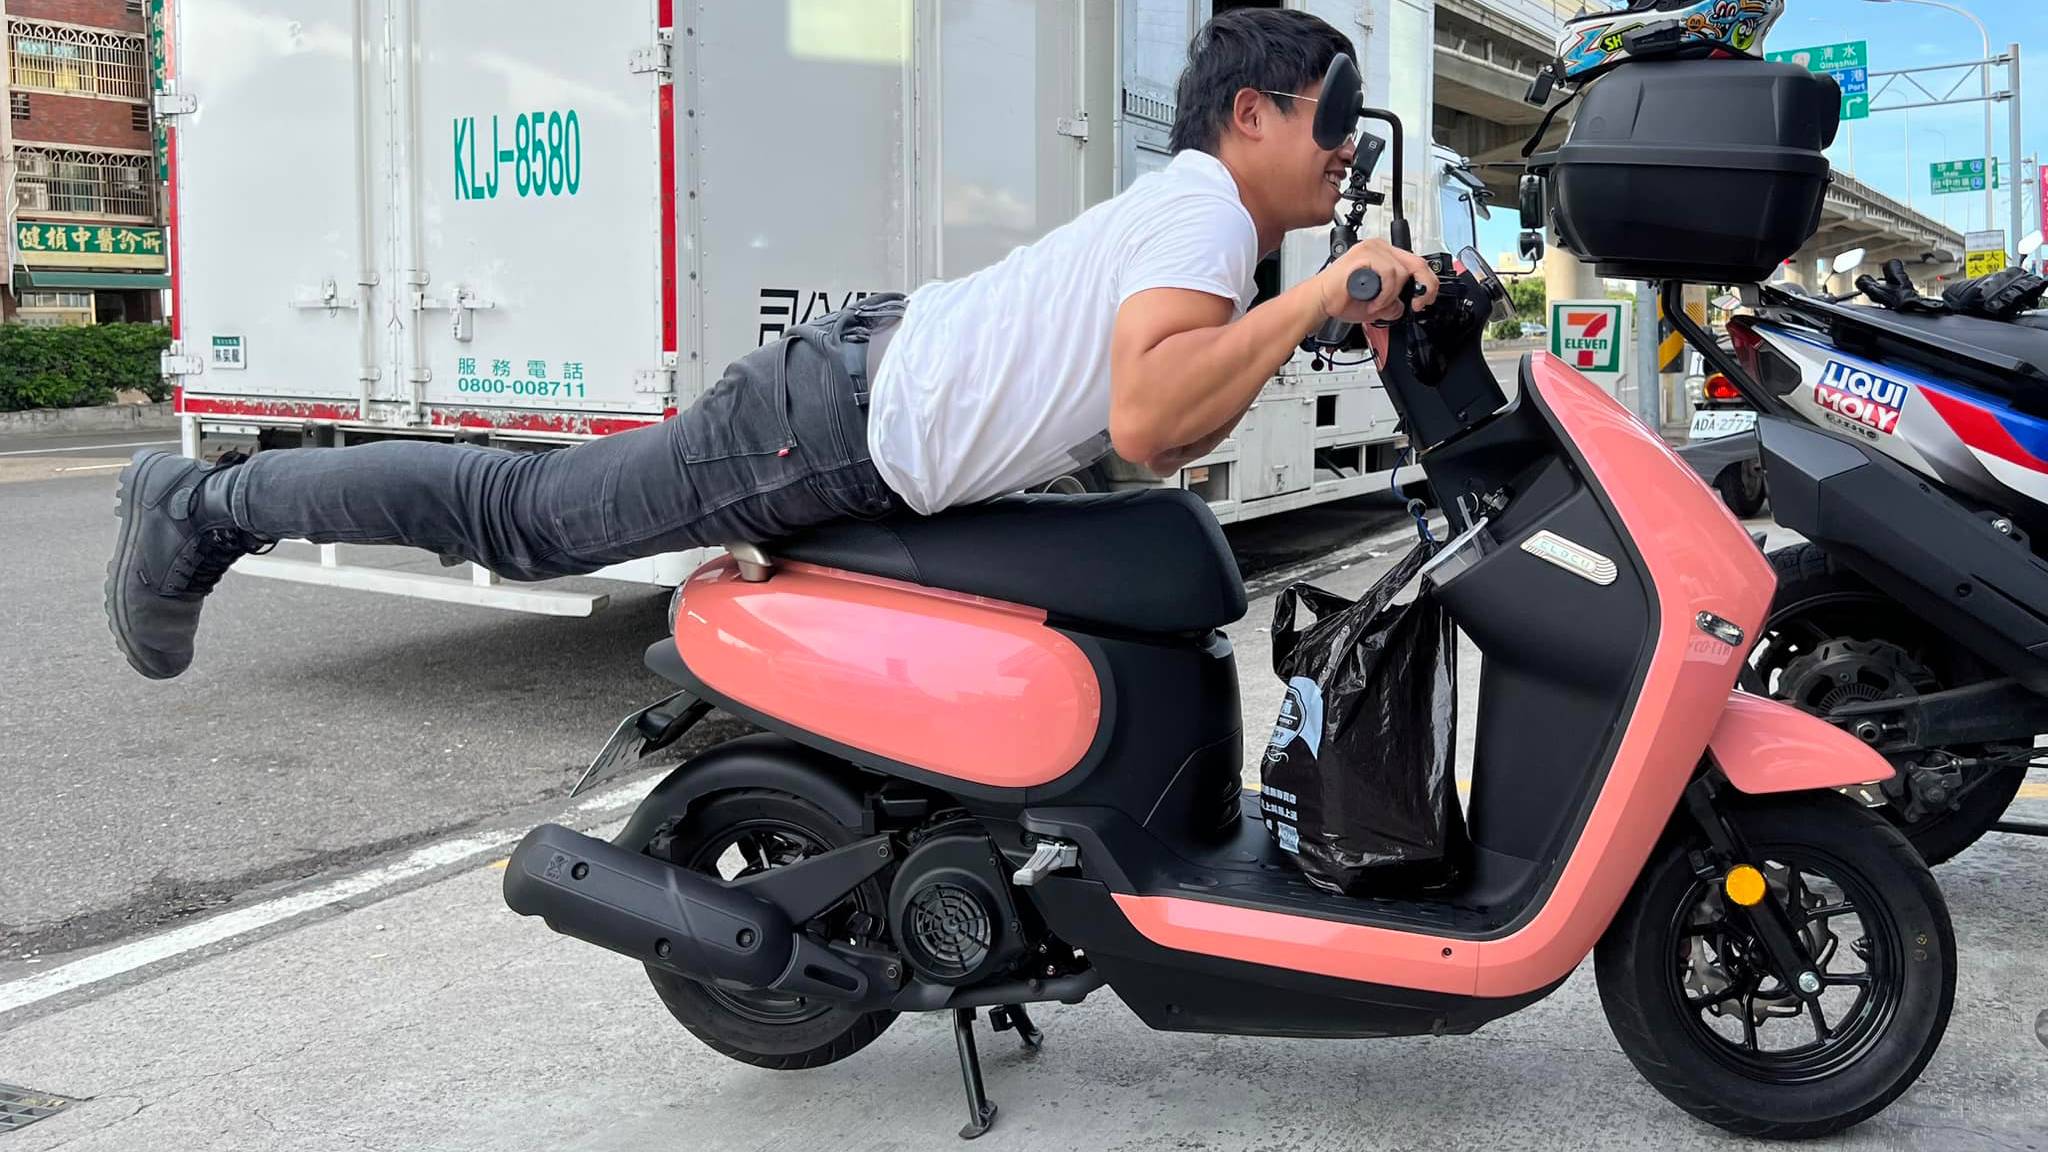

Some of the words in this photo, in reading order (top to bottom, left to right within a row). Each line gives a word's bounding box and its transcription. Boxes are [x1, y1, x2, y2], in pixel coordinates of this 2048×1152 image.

[1604, 34, 1625, 51] SH
[1821, 45, 1856, 60] 清水
[1847, 83, 1865, 92] Port
[453, 109, 580, 200] KLJ-8580
[458, 358, 583, 380] 服務電話
[458, 377, 585, 398] 0800-008711
[1824, 363, 1904, 408] LIQUI
[1818, 387, 1898, 430] MOLY
